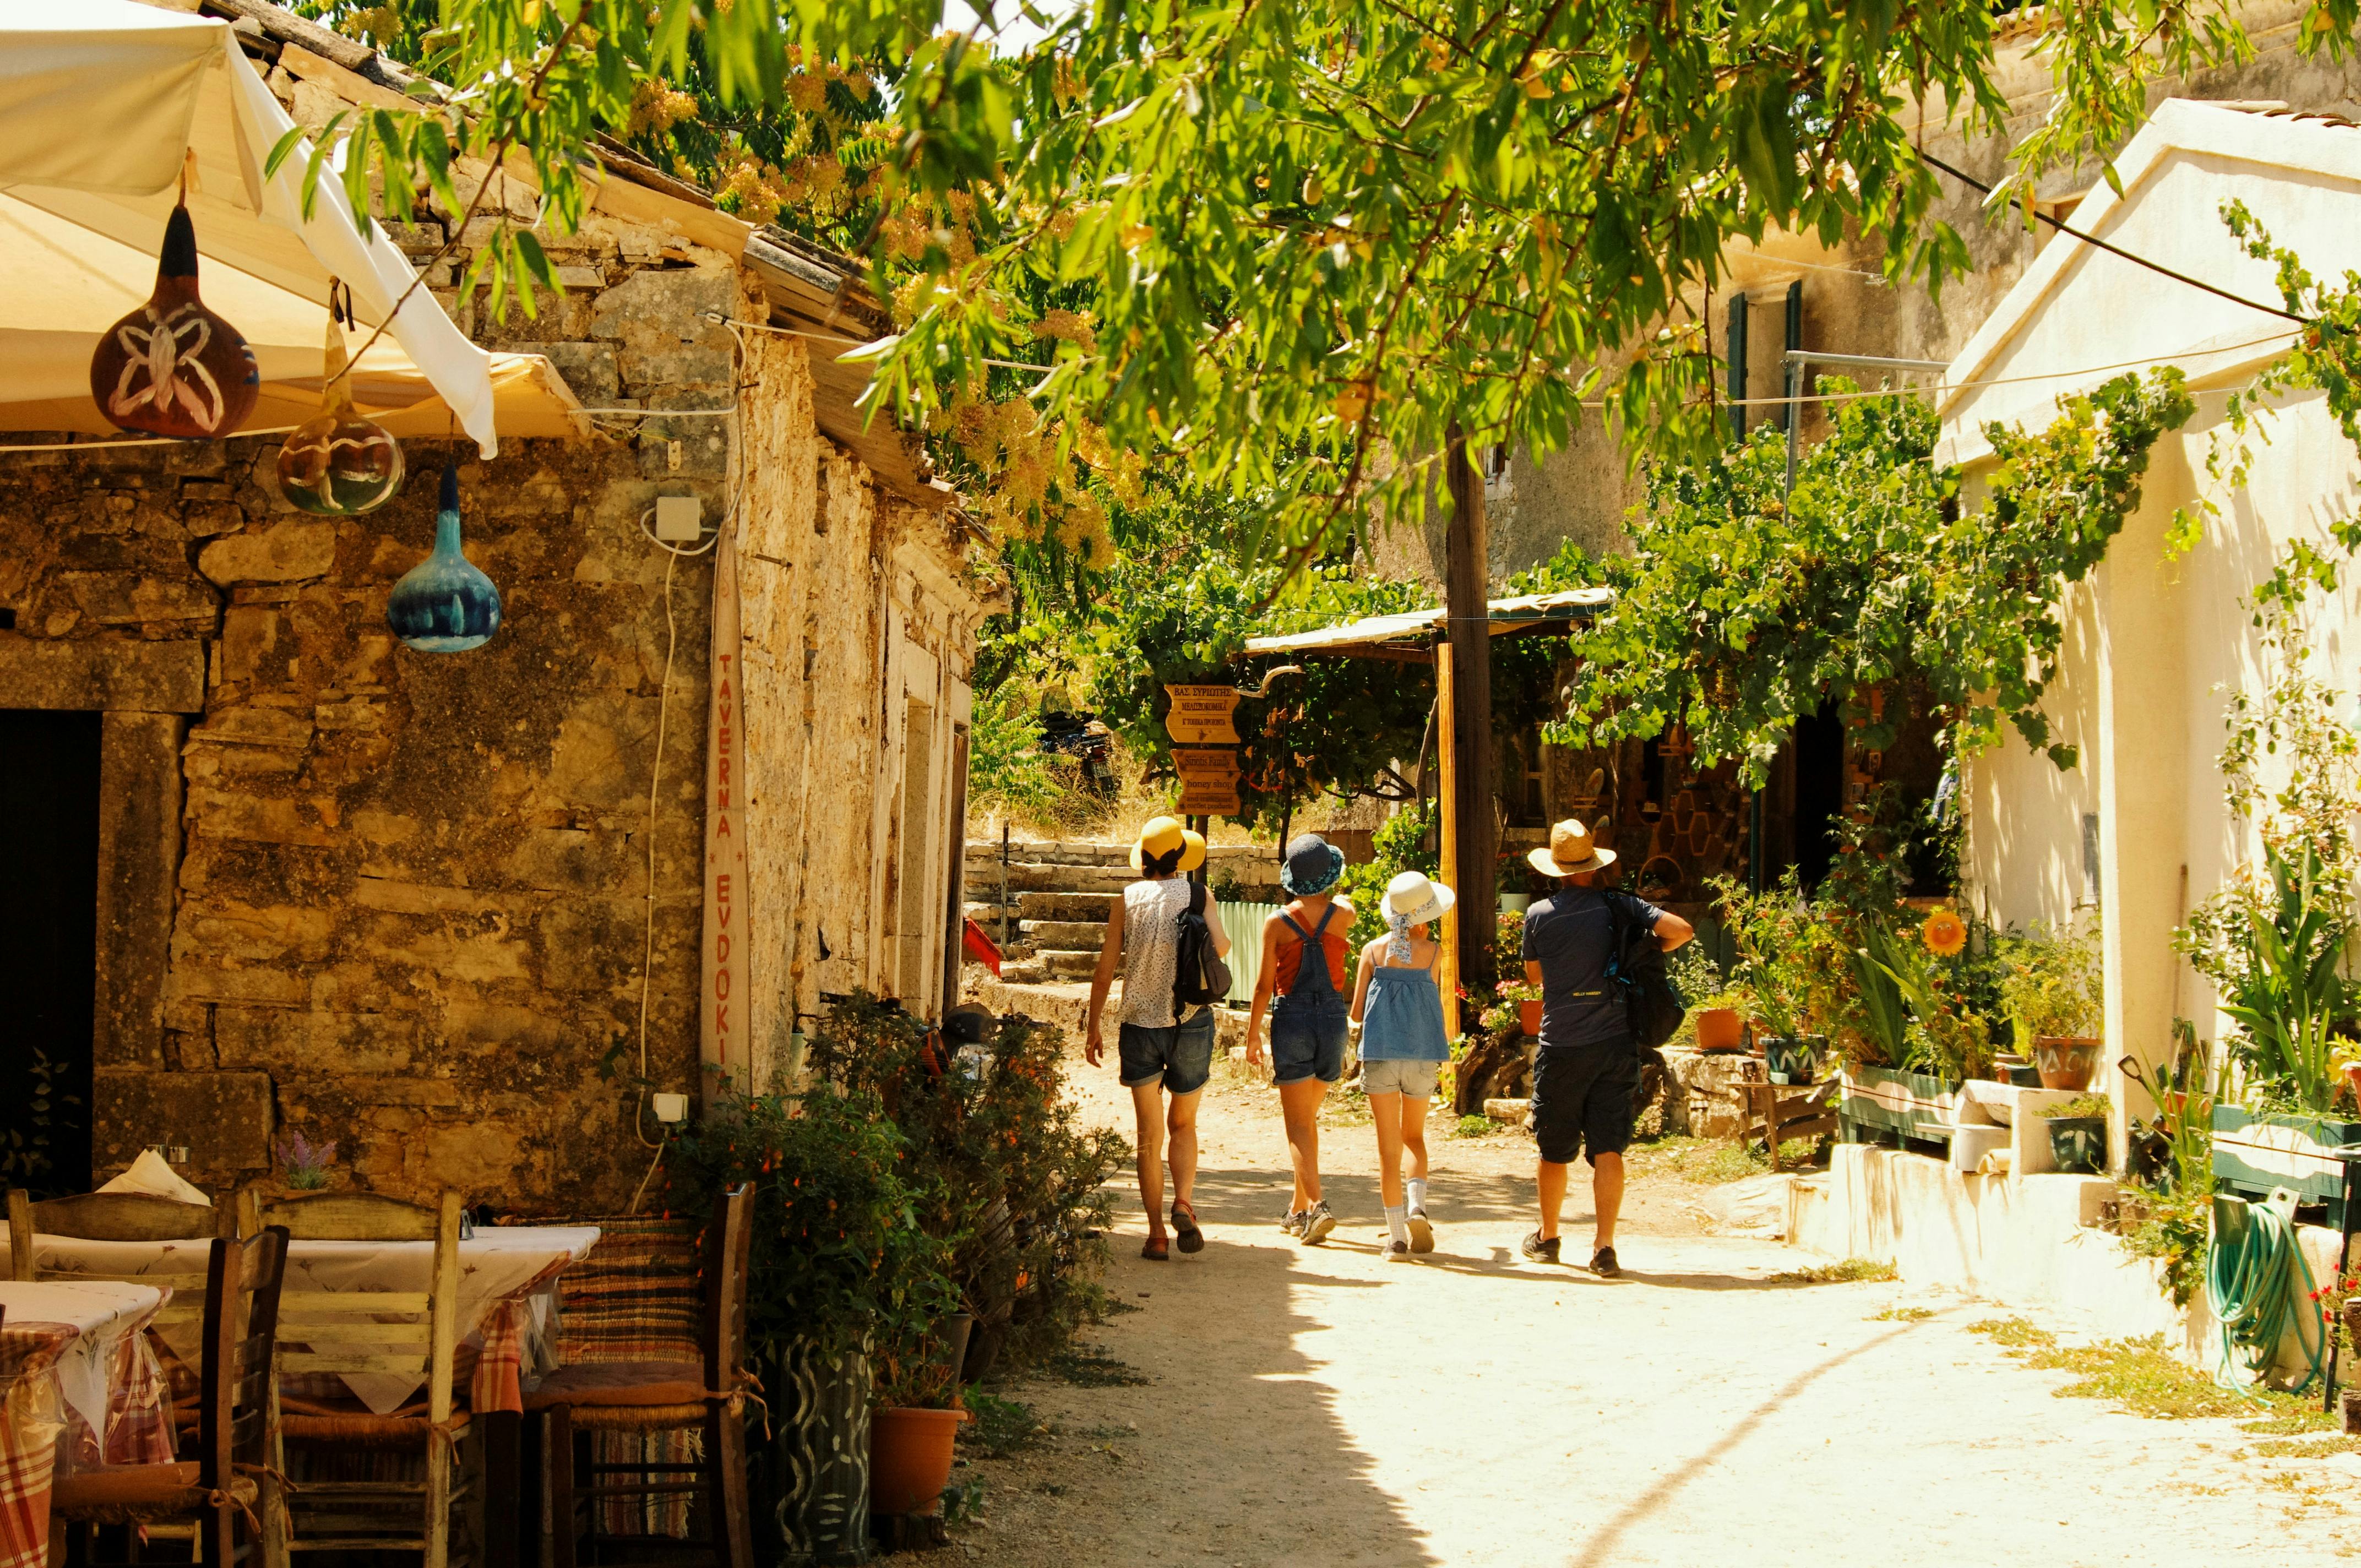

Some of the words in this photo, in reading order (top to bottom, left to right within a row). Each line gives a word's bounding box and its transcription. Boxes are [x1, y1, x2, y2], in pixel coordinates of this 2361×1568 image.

[1174, 688, 1190, 696] ΒΑΣ.
[1193, 688, 1231, 696] ΣΥΡΙΩΤΗΣ
[716, 655, 731, 837] TAVERNA
[1209, 755, 1231, 769] Family
[1187, 779, 1211, 789] honey
[1213, 778, 1232, 790] shop
